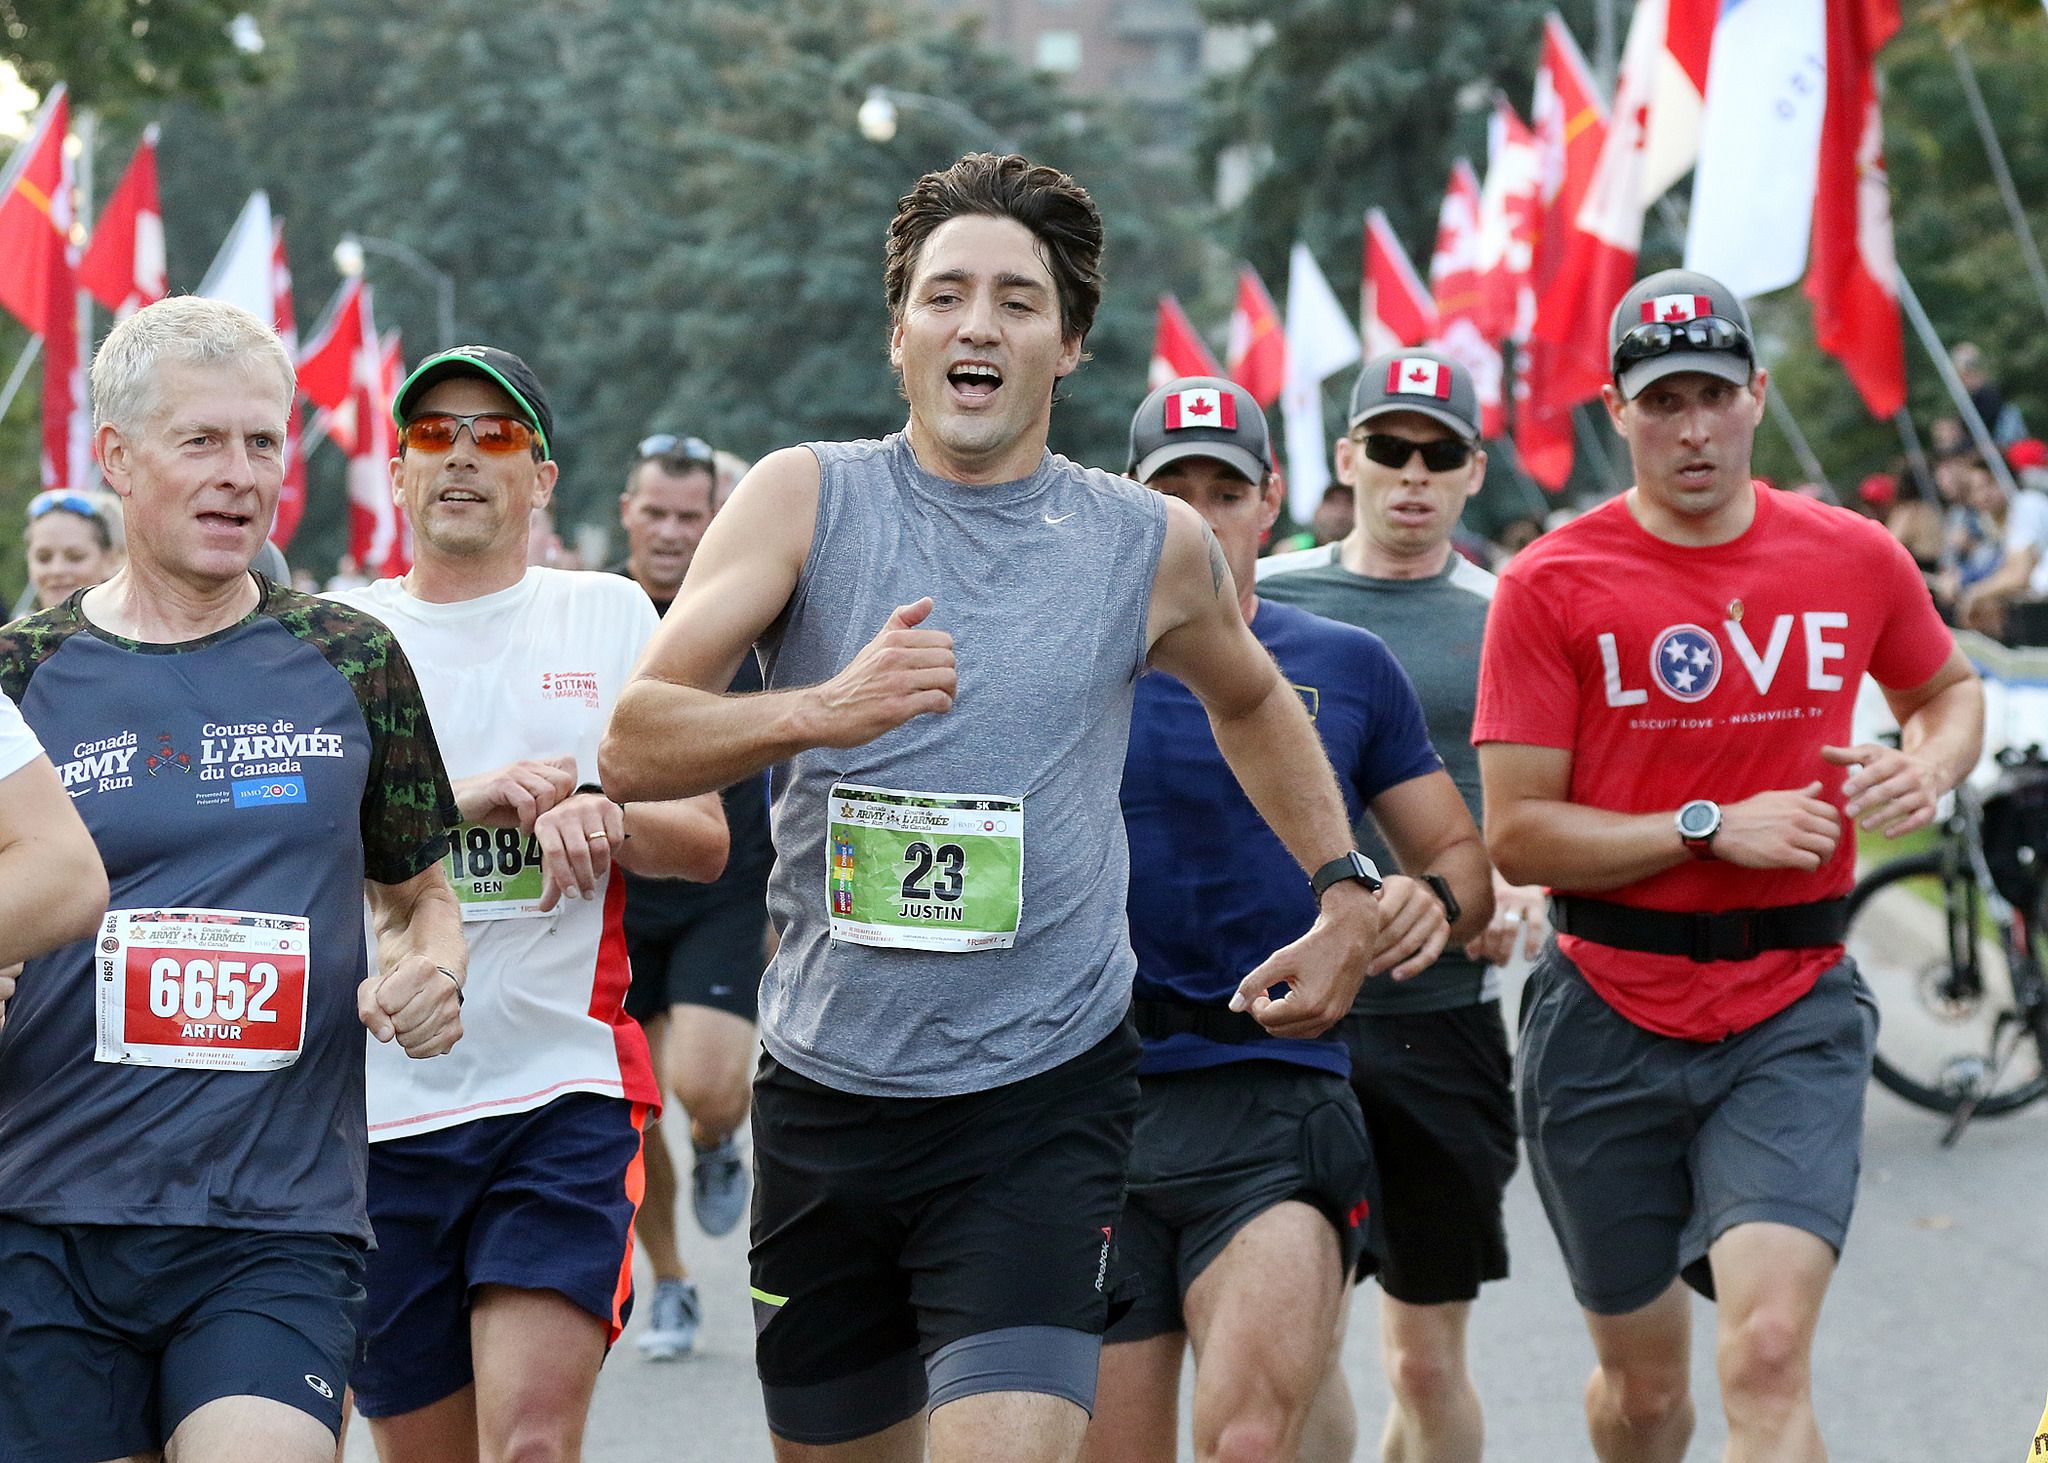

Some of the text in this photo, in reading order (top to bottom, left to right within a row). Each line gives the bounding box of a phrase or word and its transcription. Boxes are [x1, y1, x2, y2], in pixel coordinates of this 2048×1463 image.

[555, 680, 598, 690] OTTAWA
[555, 690, 599, 700] MARATHON
[202, 719, 295, 738] Course de
[1629, 718, 1677, 730] BISCUIT
[1680, 718, 1714, 729] LOVE
[73, 730, 138, 759] Canada
[200, 727, 345, 765] L'ARMÉE
[199, 758, 302, 781] du Canada
[98, 775, 134, 793] Run
[856, 809, 886, 820] ARMY
[866, 804, 886, 812] Canada
[976, 801, 990, 811] 5K
[902, 814, 950, 827] L'ARMÉE
[901, 841, 966, 902] 23
[473, 881, 503, 893] BEN
[899, 903, 963, 921] JUSTIN
[106, 915, 118, 933] 6652
[149, 930, 180, 939] ARMY
[200, 931, 247, 943] L'ARMÉE
[103, 960, 114, 982] 6652
[148, 956, 279, 1024] 6652
[181, 1023, 243, 1040] ARTUR
[1094, 1240, 1110, 1292] Reebok
